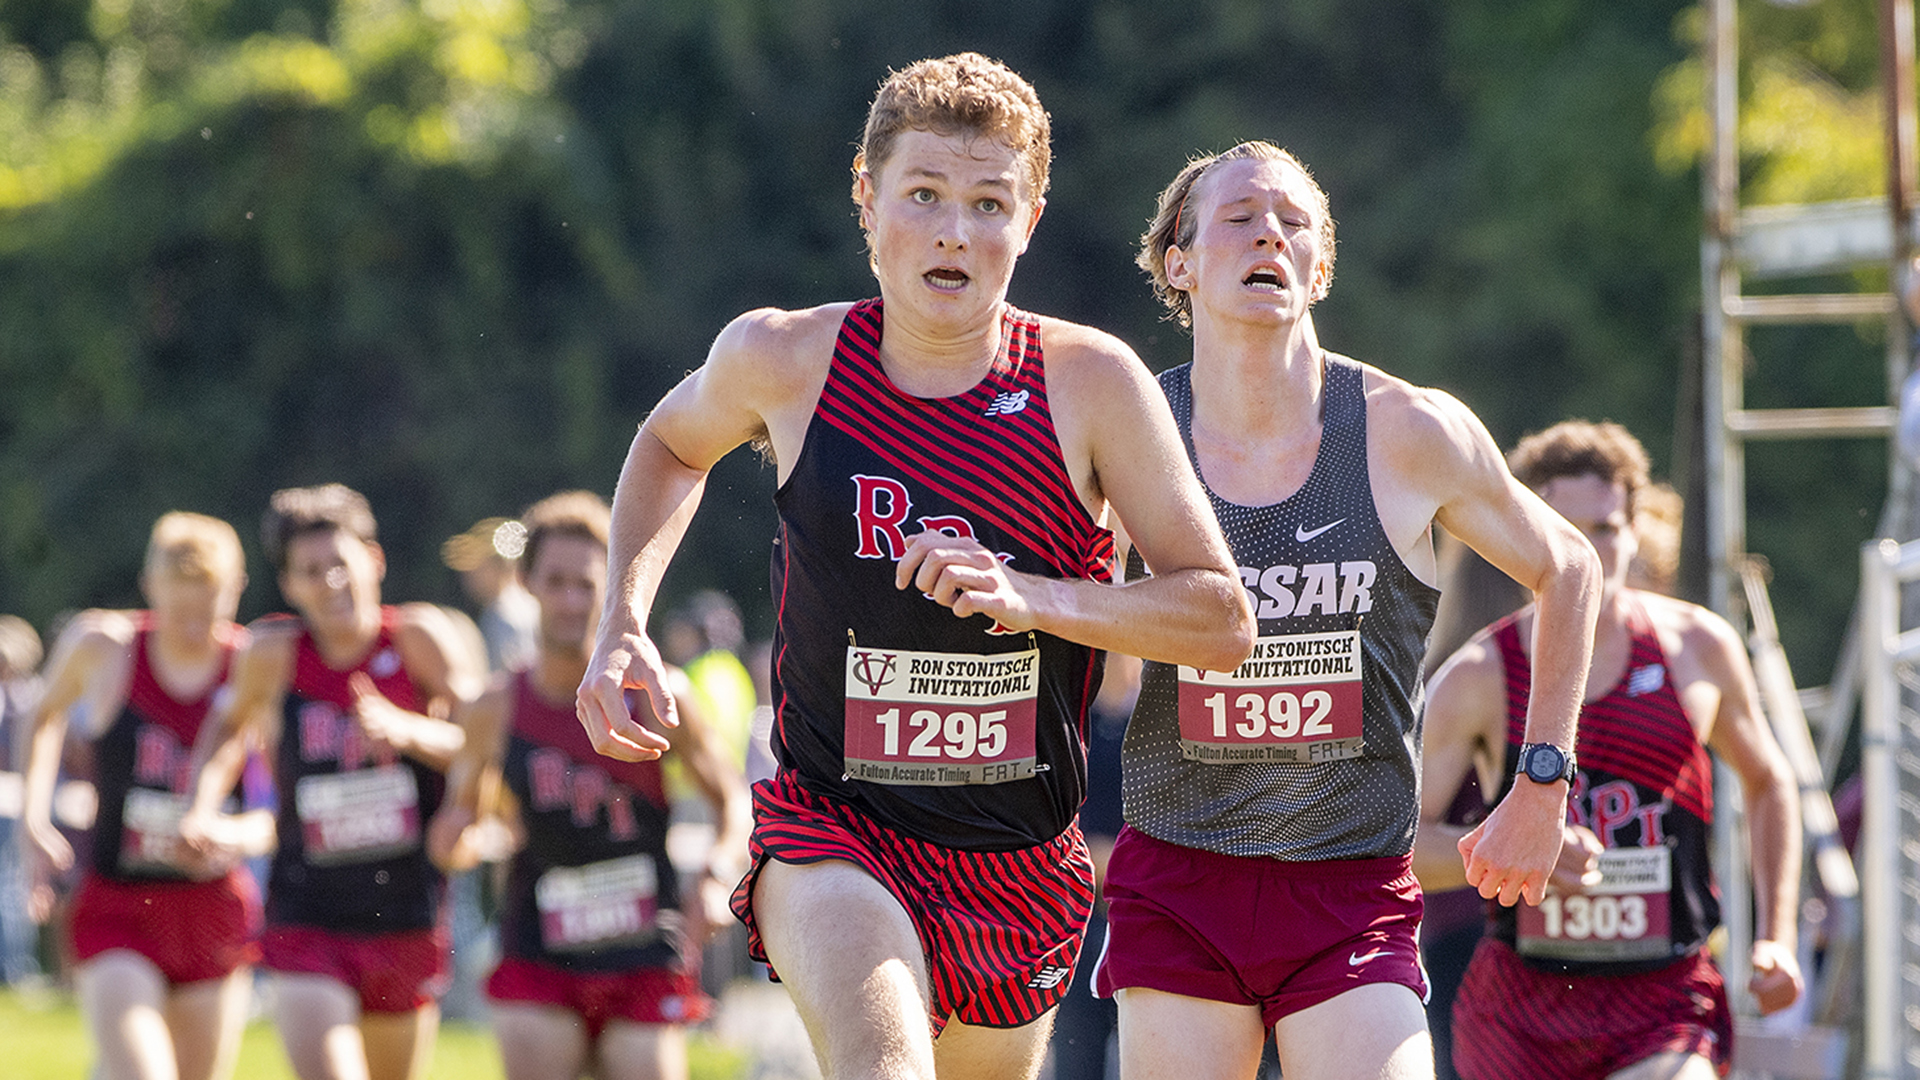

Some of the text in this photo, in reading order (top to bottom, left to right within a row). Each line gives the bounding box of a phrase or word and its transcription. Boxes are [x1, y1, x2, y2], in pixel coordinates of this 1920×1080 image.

[1266, 637, 1353, 659] STONITSCH
[910, 657, 1032, 677] RON STONITSCH
[908, 675, 1031, 697] INVITATIONAL
[1204, 690, 1333, 738] 1392
[876, 708, 1007, 759] 1295
[1193, 745, 1297, 761] Fulton Accurate Timing
[860, 763, 970, 784] Fulton Accurate Timing
[1540, 894, 1648, 940] 1303
